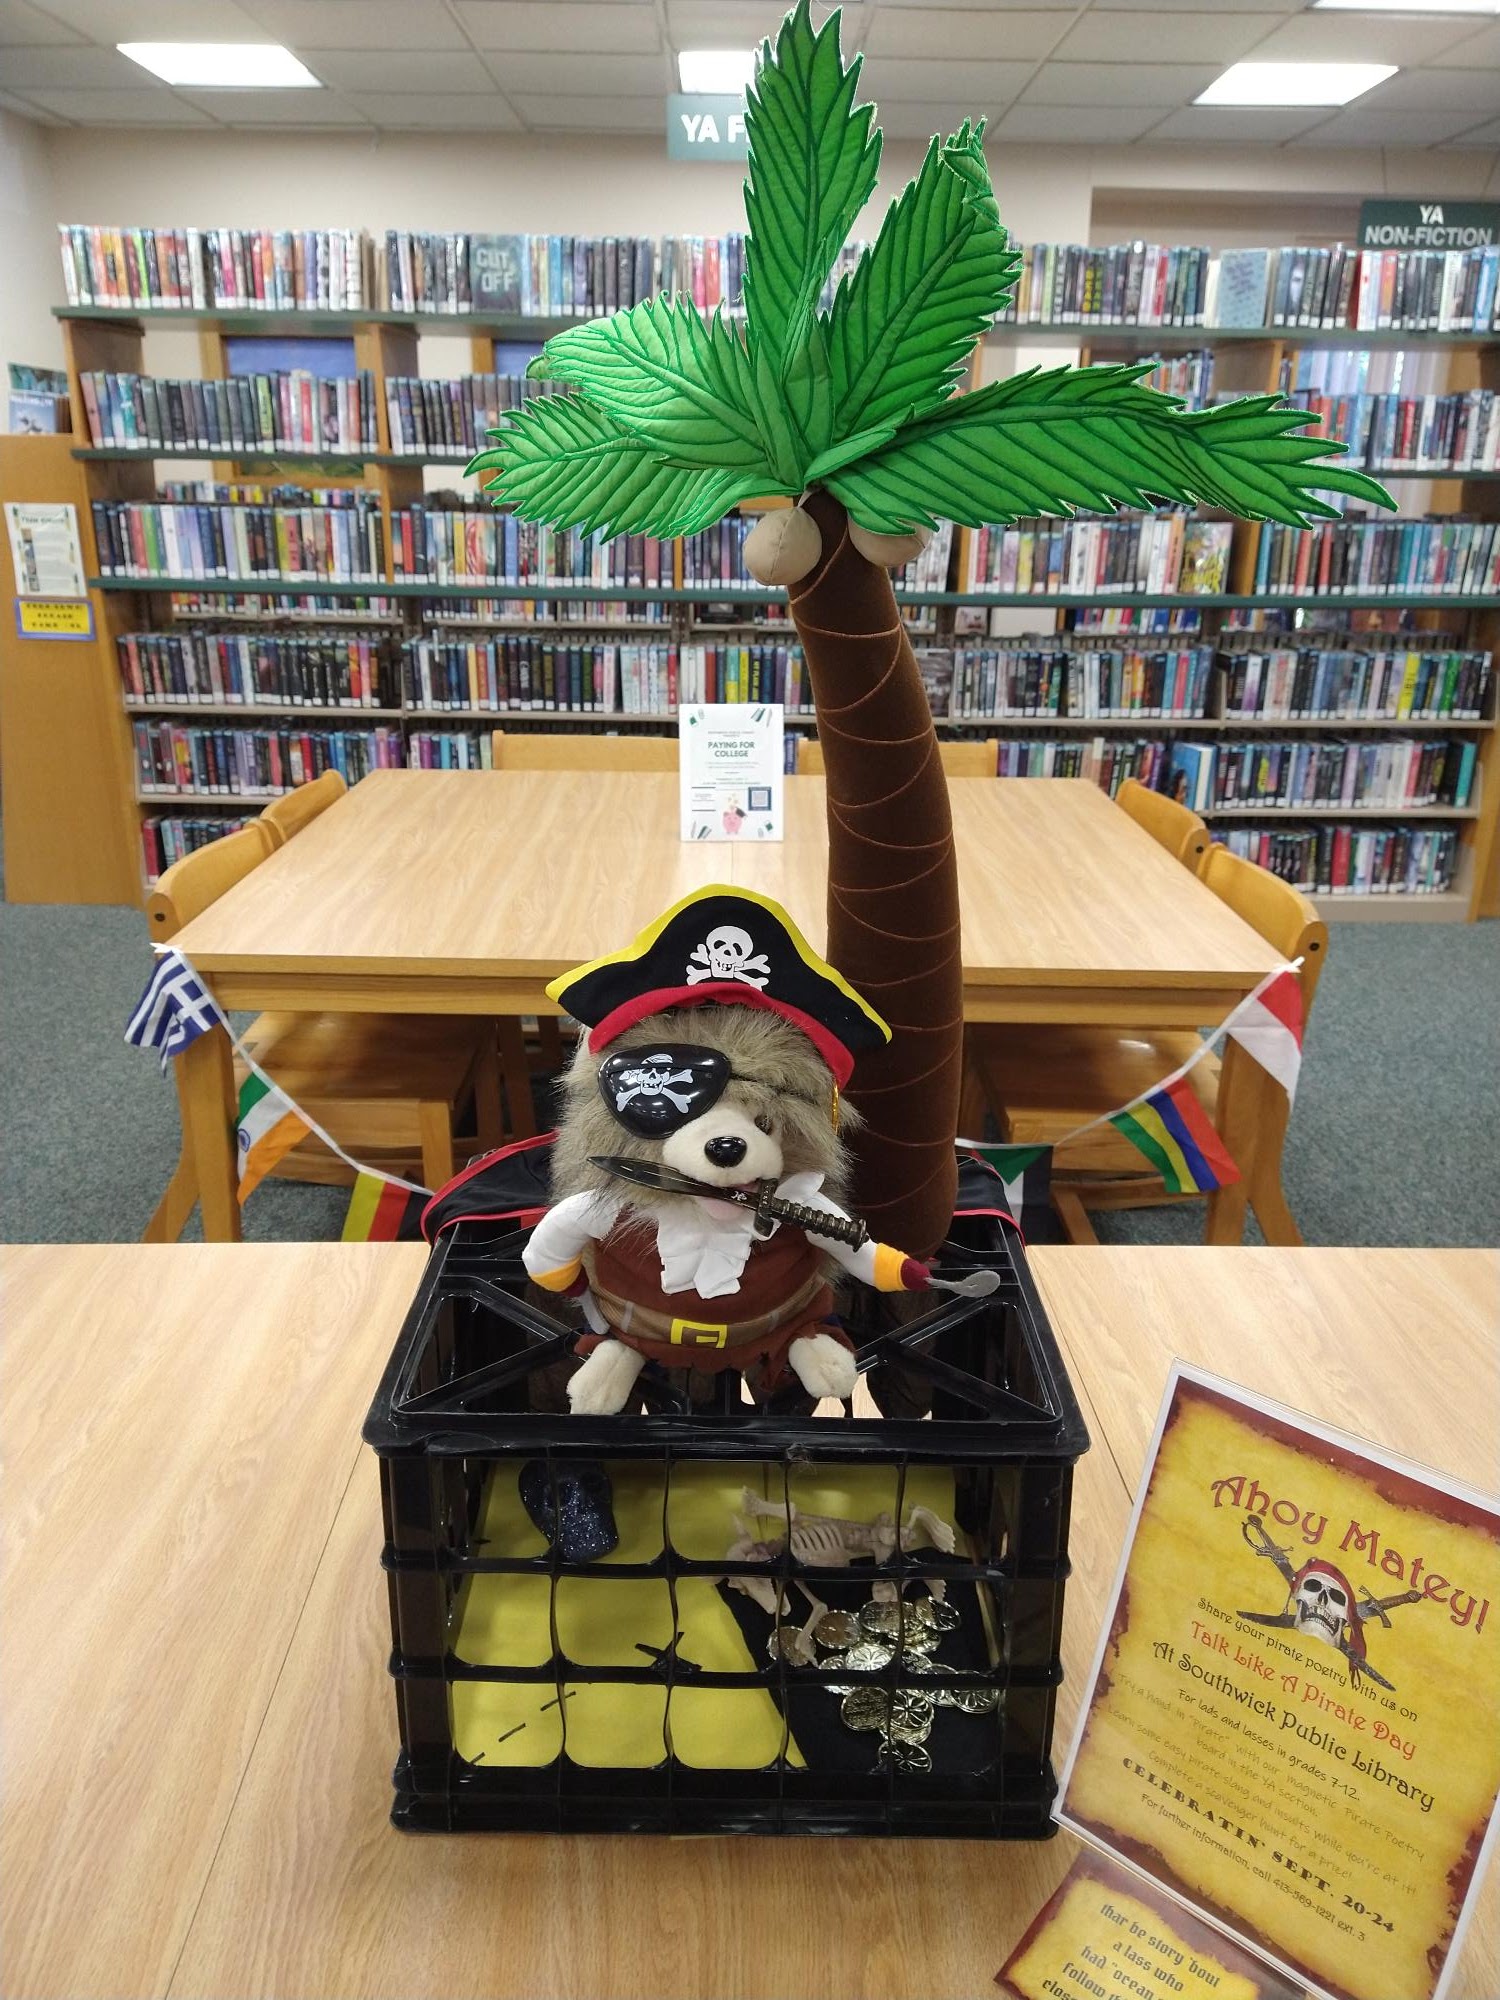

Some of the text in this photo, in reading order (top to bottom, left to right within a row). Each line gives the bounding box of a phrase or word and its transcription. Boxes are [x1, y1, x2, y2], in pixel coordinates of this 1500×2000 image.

[681, 114, 751, 142] YA F
[1420, 205, 1444, 224] YA
[1364, 225, 1492, 246] NON-FICTION
[476, 248, 509, 268] CUT
[481, 272, 513, 292] OFF
[708, 741, 755, 749] PAYING FOR
[714, 750, 749, 758] COLLEGE
[1211, 1476, 1490, 1634] Ahoy Matey!
[1198, 1598, 1418, 1722] Share your pirate poetry with us on
[1191, 1621, 1417, 1760] Talk Like A Pirate Day
[1153, 1641, 1435, 1813] At Southwick Public Library
[1178, 1688, 1360, 1801] For lads and lasses in grades 7-12.
[1236, 1744, 1260, 1765] with
[1262, 1761, 1280, 1774] our
[1287, 1775, 1338, 1809] magnetic
[1239, 1762, 1259, 1780] the
[1262, 1775, 1275, 1792] YA
[1252, 1793, 1272, 1809] and
[1122, 1757, 1395, 1933] CELEBRATIN' SEPT. 20-24
[1289, 1836, 1306, 1852] for
[1141, 1793, 1159, 1809] For
[1158, 1804, 1192, 1832] further
[1252, 1865, 1272, 1883] call
[1272, 1878, 1336, 1924] 413-569-1221
[1337, 1919, 1355, 1937] ext.
[1357, 1931, 1366, 1942] 3
[1080, 1945, 1108, 1970] had
[1129, 1921, 1147, 1939] be
[1147, 1937, 1185, 1966] story
[1061, 1961, 1107, 1998] follow
[1112, 1941, 1185, 1993] a lass who
